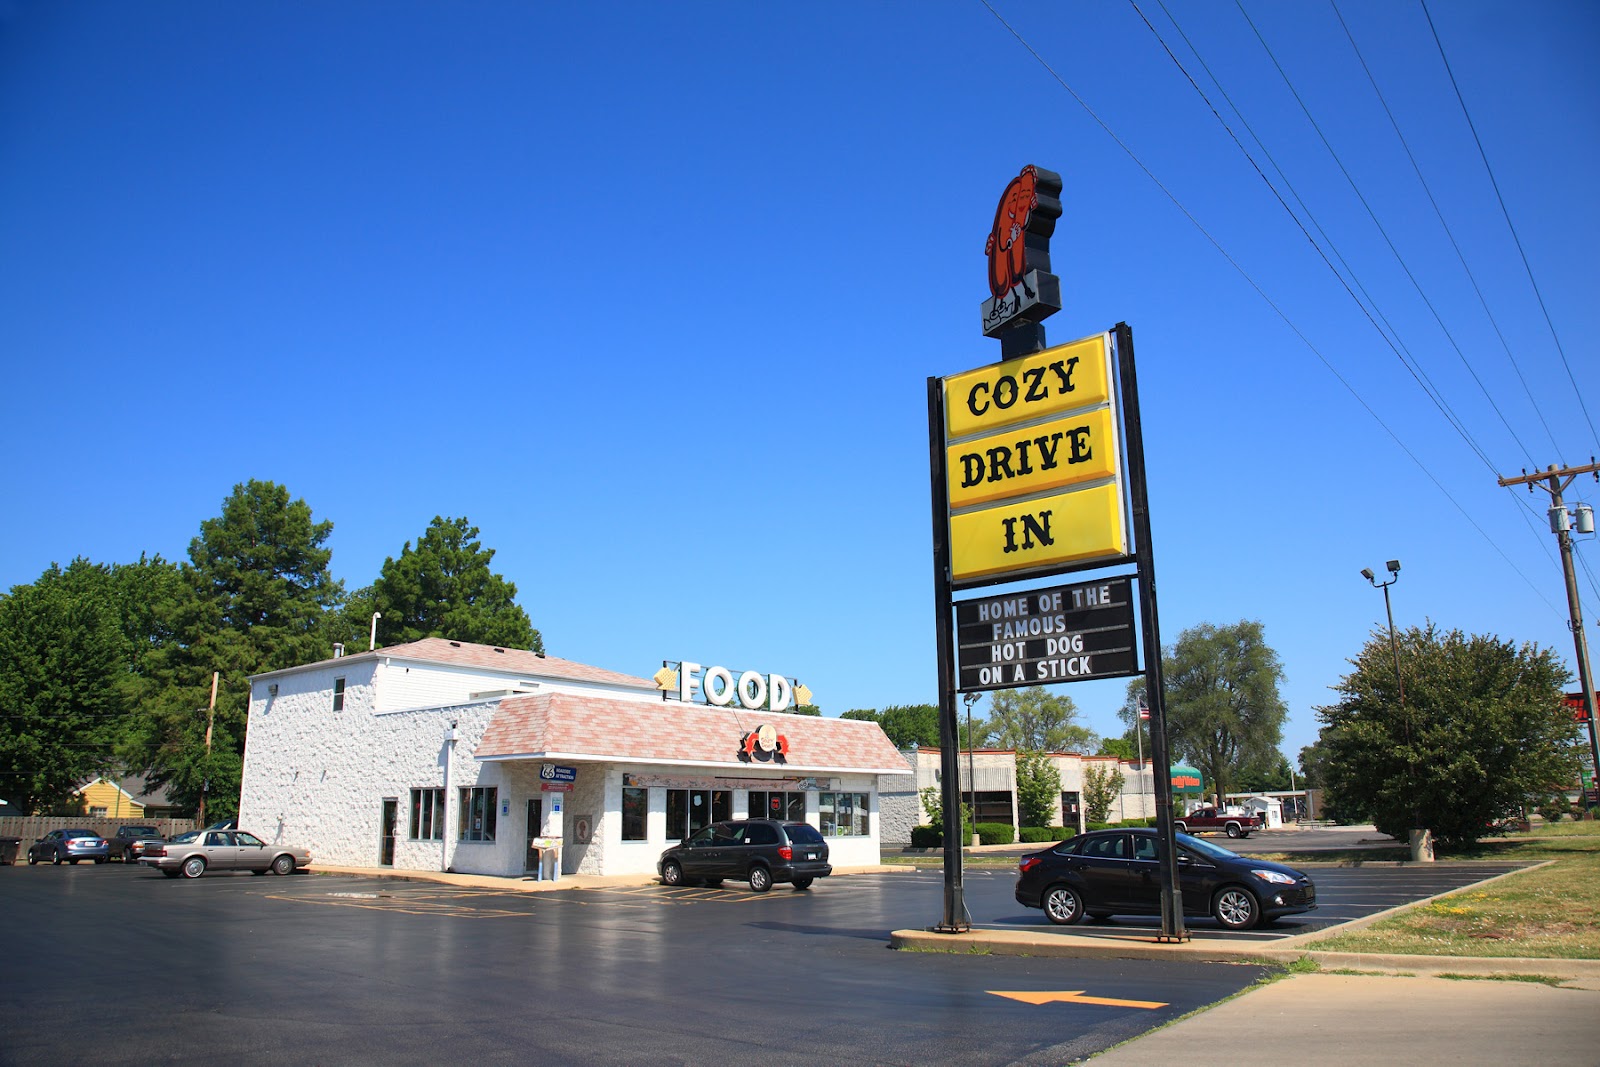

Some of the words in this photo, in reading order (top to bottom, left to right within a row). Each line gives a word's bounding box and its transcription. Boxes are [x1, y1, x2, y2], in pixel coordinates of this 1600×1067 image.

[967, 357, 1080, 416] COZY
[960, 426, 1092, 488] DRIVE
[1002, 510, 1054, 553] IN
[979, 598, 1028, 622] HOME
[1038, 592, 1062, 612] OF
[1072, 585, 1111, 607] THE
[992, 614, 1066, 640] FAMOUS
[991, 641, 1026, 662] HOT
[1047, 634, 1084, 656] DOG
[680, 661, 791, 711] FOOD
[979, 666, 1002, 685] ON
[1013, 664, 1025, 682] A
[1036, 655, 1092, 680] STICK
[543, 768, 554, 777] 66
